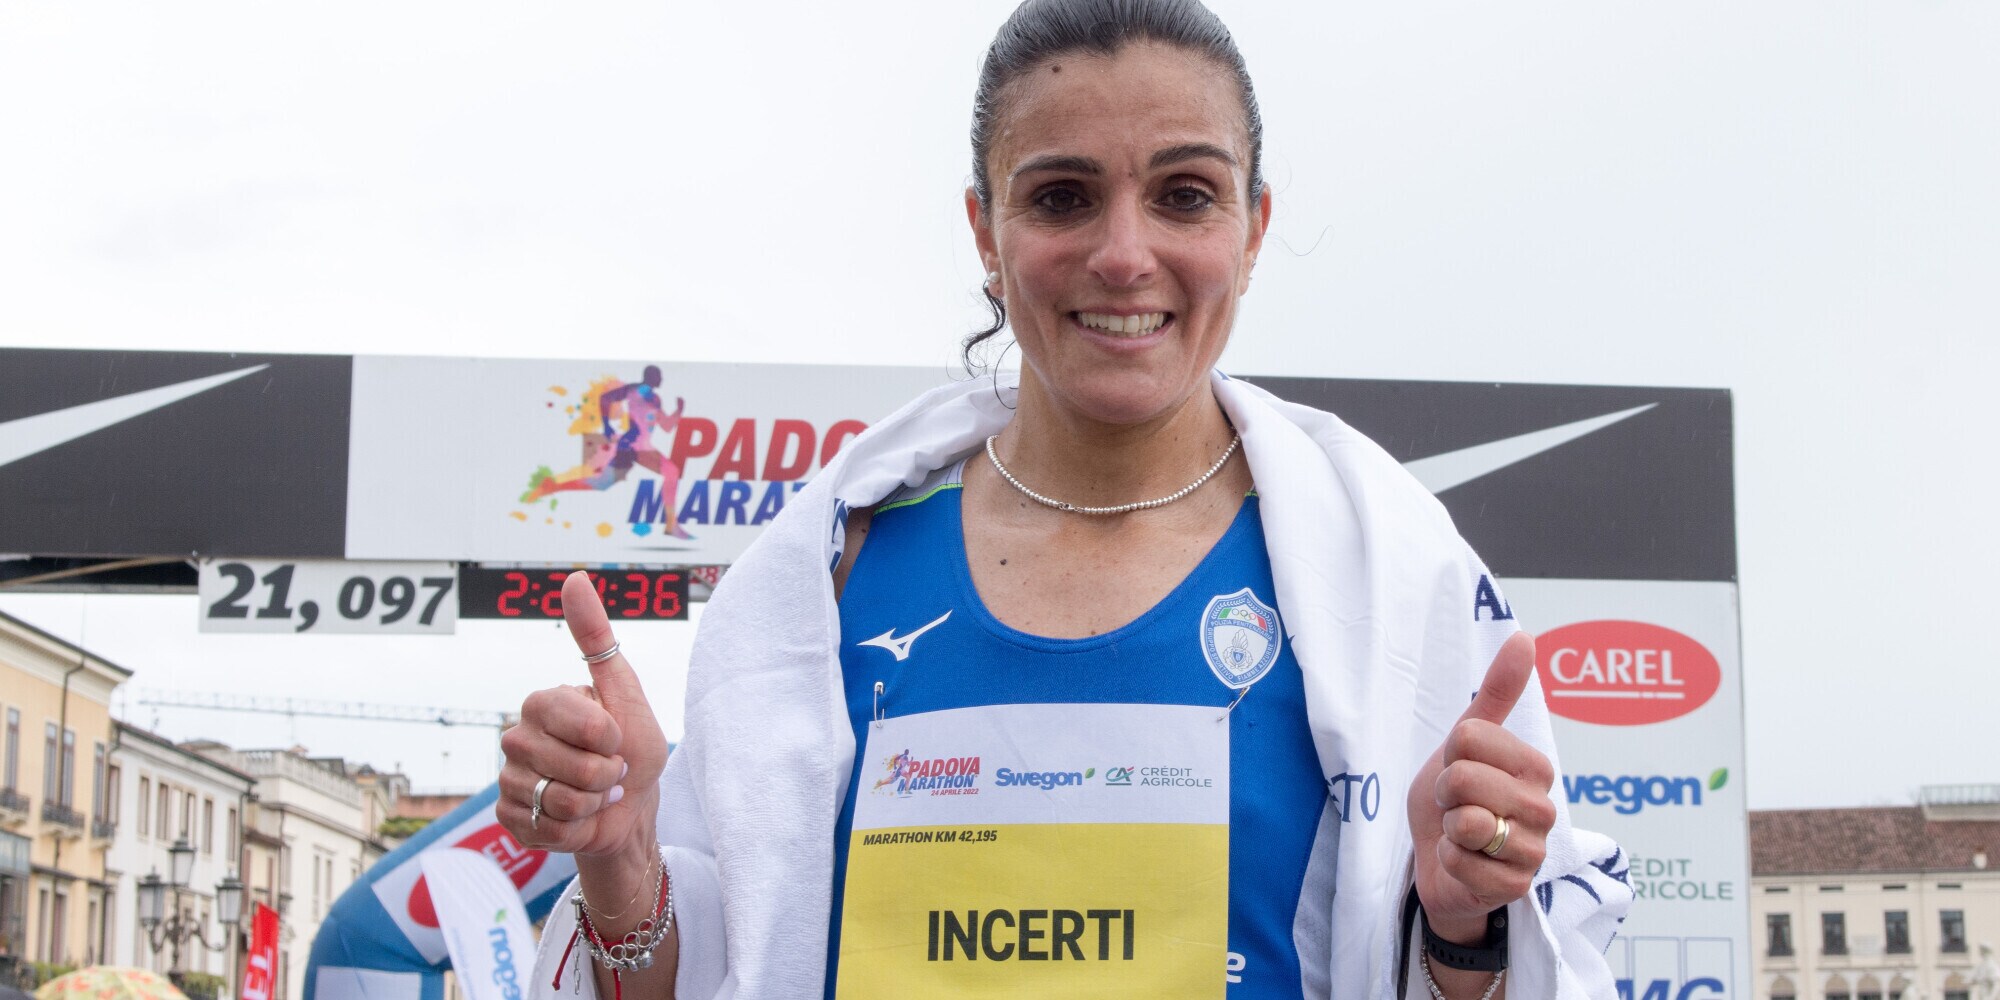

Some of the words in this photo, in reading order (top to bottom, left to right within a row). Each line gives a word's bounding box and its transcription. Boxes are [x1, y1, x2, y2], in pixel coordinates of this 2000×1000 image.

[338, 575, 454, 626] 097
[1207, 627, 1216, 652] GRUPPO
[1210, 618, 1233, 627] POLIZIA
[1232, 619, 1273, 641] PENITENZIARIA
[1211, 651, 1234, 680] SPORTIVO
[1237, 667, 1260, 682] FIAMME
[1258, 643, 1275, 669] AZZURRE
[1550, 648, 1684, 685] CAREL
[908, 756, 981, 778] PADOVA
[995, 767, 1083, 790] Swegon
[1140, 765, 1193, 777] CRÉDIT
[896, 774, 975, 792] MARATHON
[930, 789, 939, 797] 24
[940, 788, 962, 796] APRILE
[963, 787, 979, 795] 2022
[1140, 777, 1213, 788] AGRICOLE
[863, 832, 933, 845] MARATHON
[935, 830, 957, 842] KM
[959, 830, 998, 844] 42,195
[927, 908, 1135, 962] INCERTI
